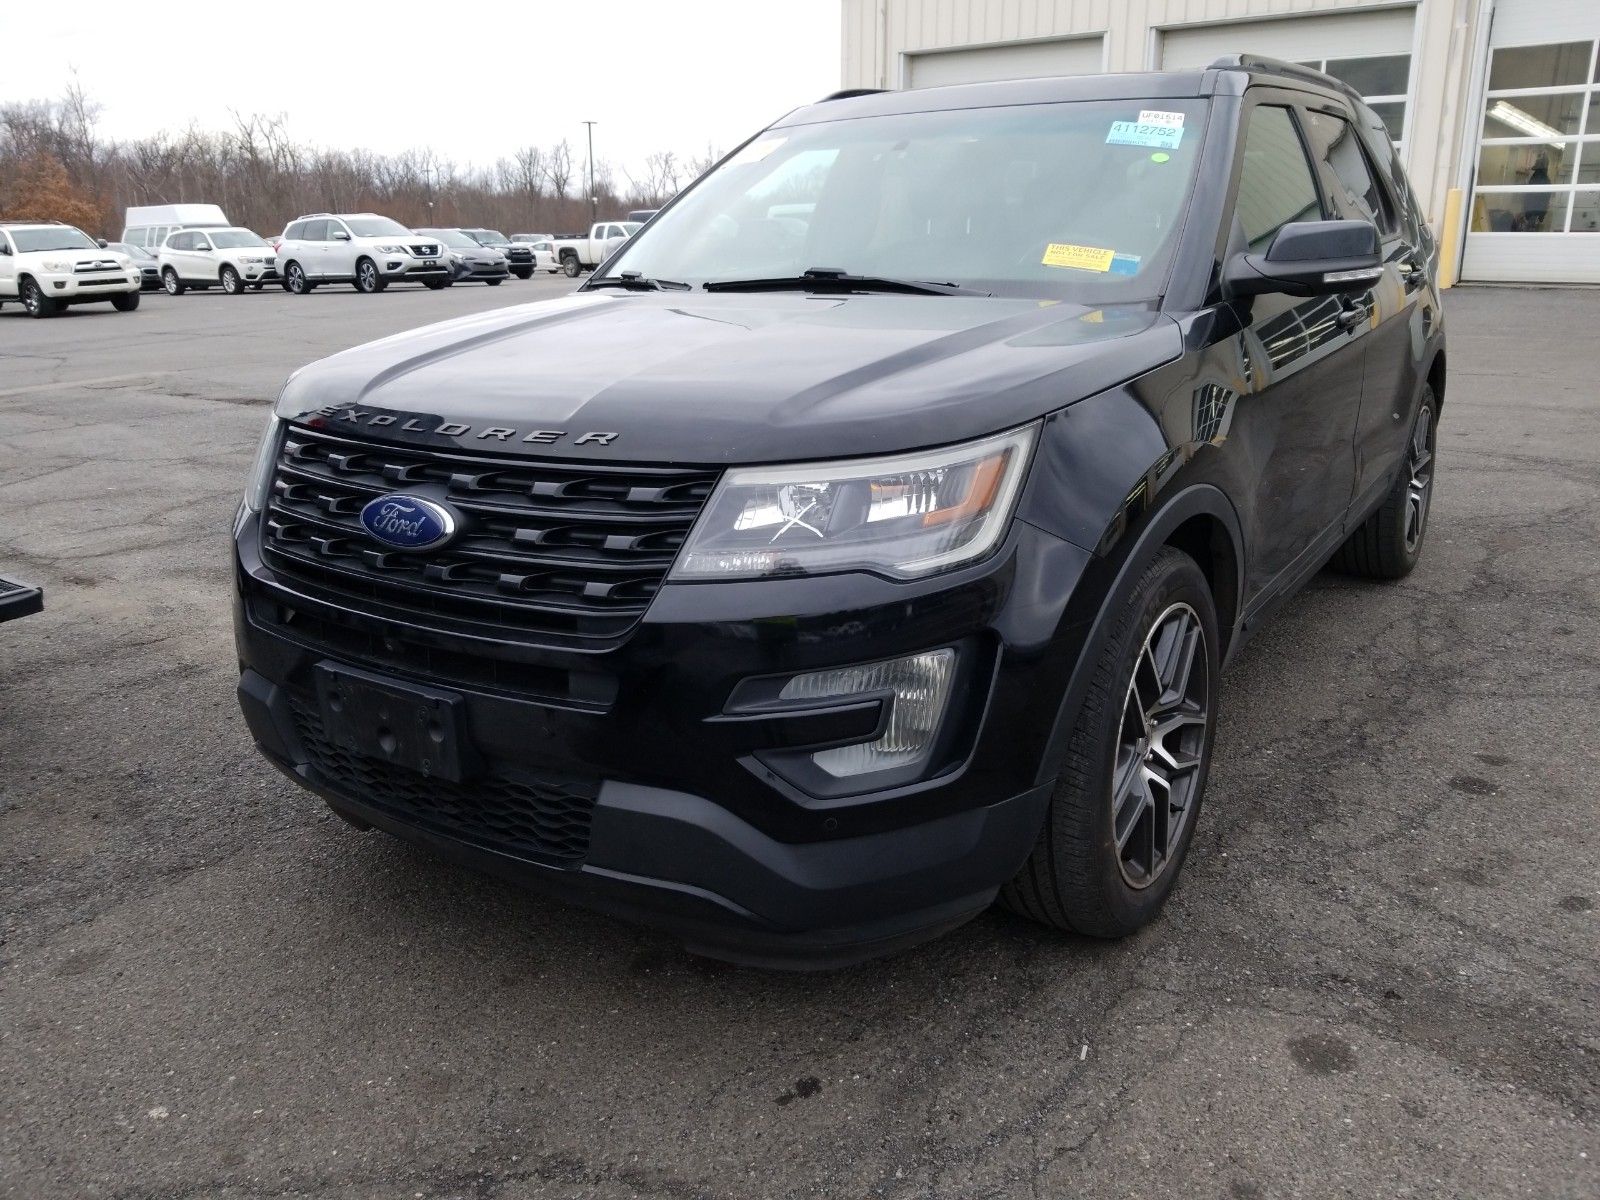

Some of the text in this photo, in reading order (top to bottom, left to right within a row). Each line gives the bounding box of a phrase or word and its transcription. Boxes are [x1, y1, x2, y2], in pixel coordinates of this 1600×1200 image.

[1114, 124, 1177, 137] 4112752
[1072, 247, 1107, 255] VEHICLE
[316, 405, 620, 446] EXPLORER
[373, 502, 427, 537] Ford
